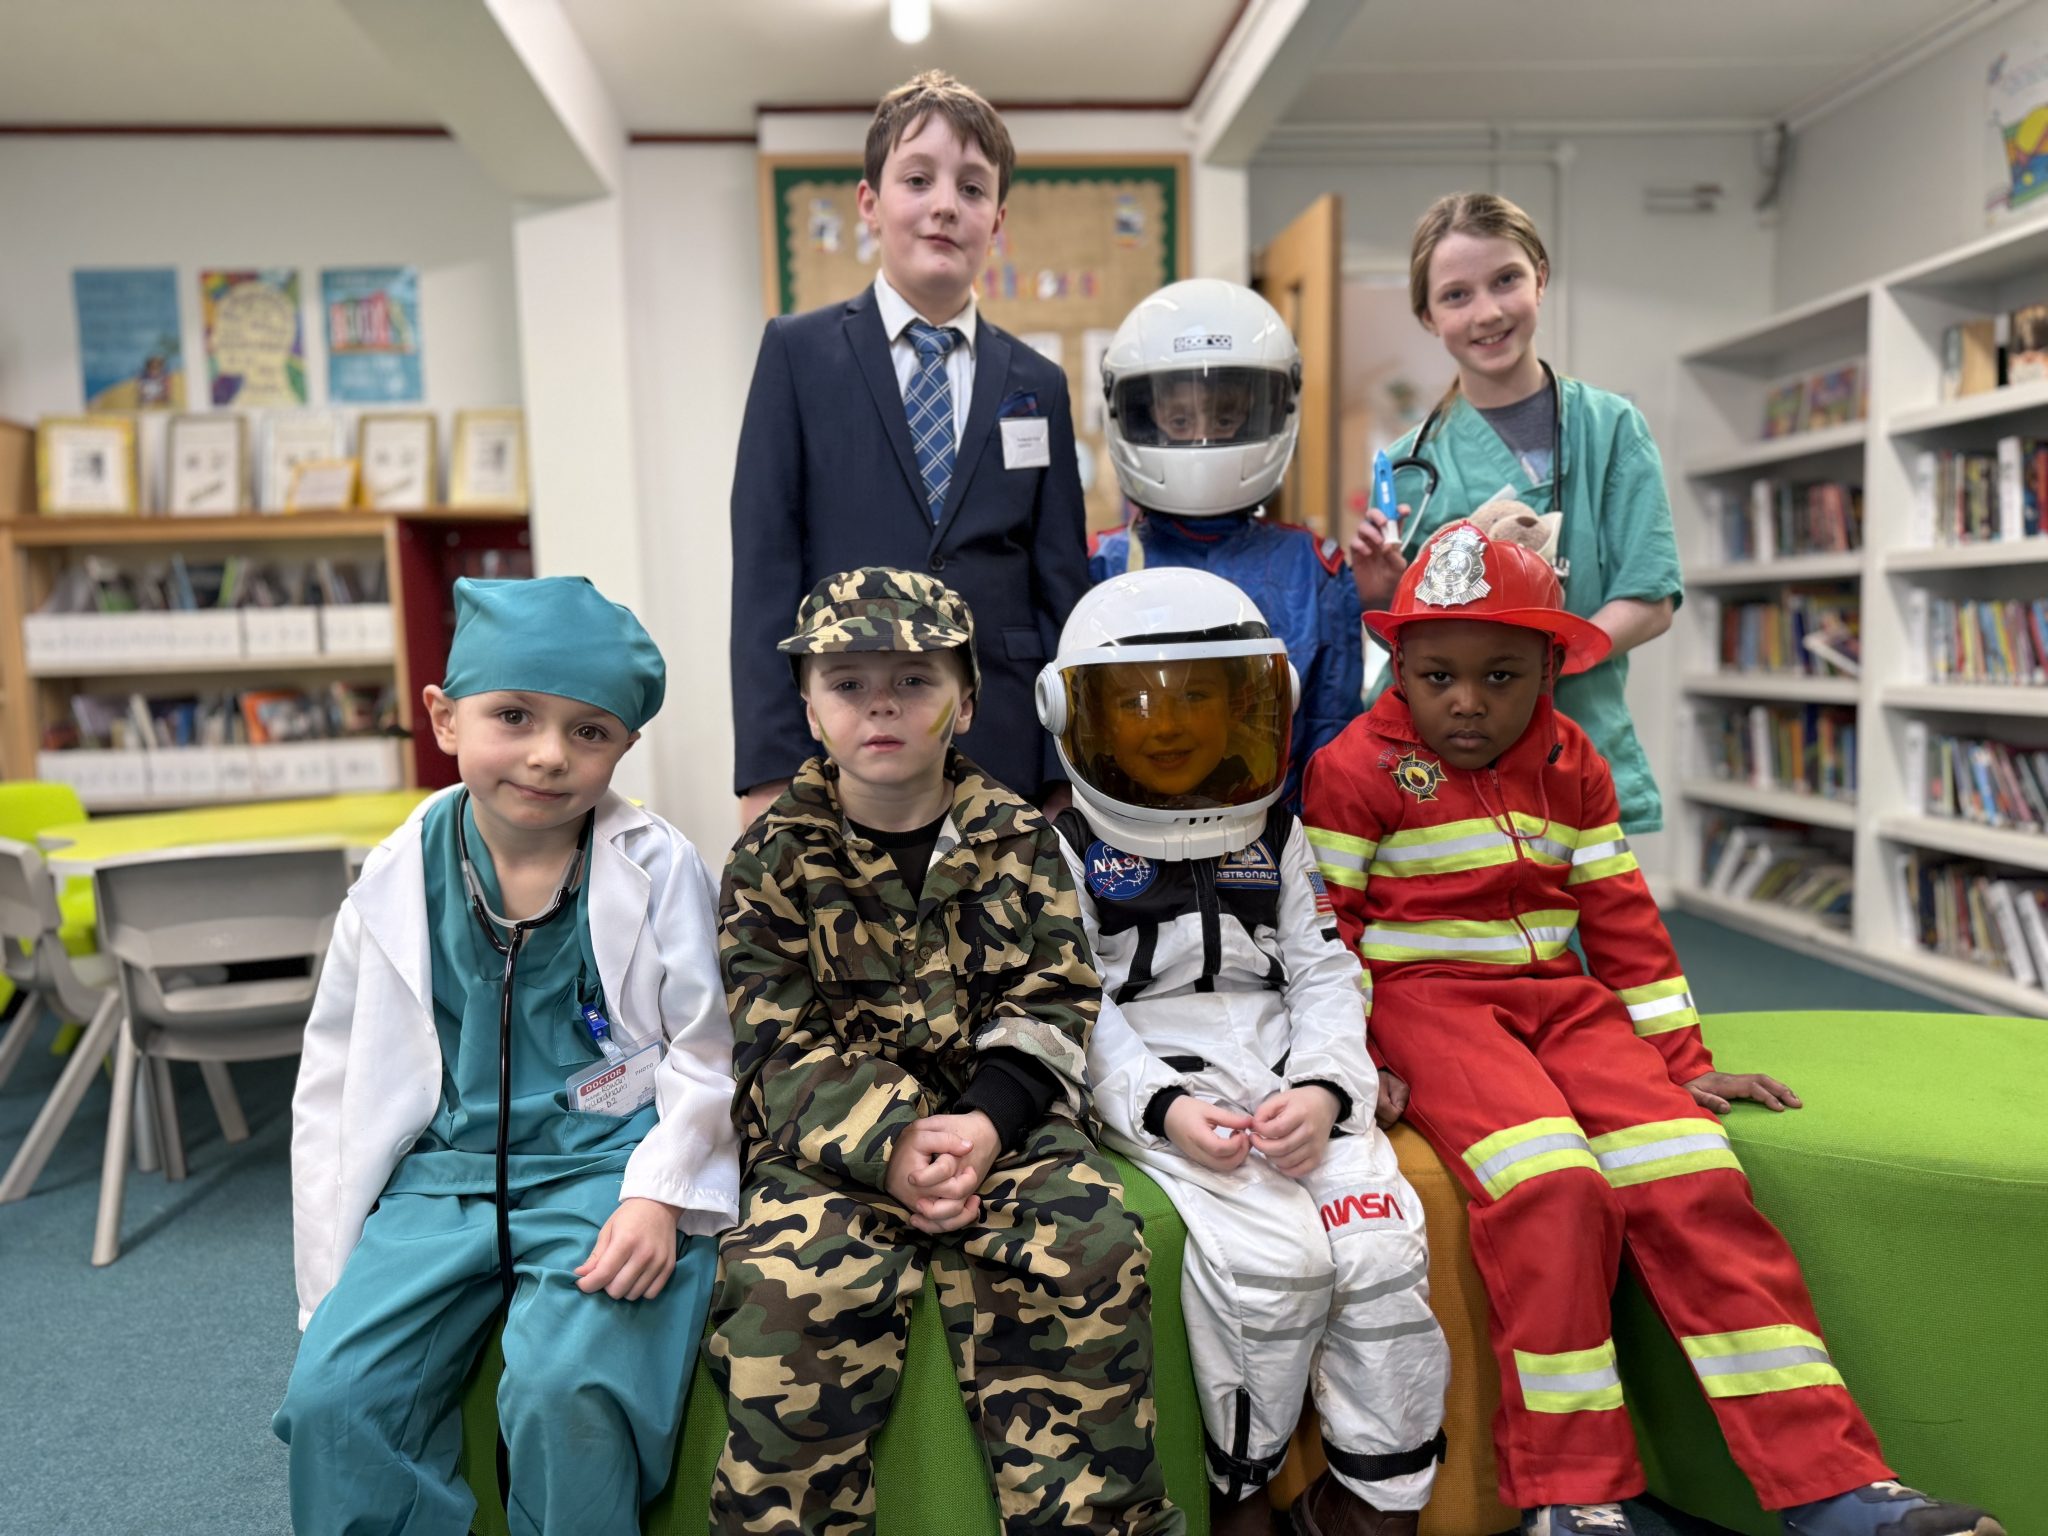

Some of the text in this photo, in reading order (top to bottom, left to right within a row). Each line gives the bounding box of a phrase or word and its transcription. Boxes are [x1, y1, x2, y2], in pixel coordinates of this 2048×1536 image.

[1093, 857, 1151, 873] NASA
[1216, 871, 1278, 880] ASTRONAUT
[635, 1062, 654, 1076] PHOTO
[586, 1068, 622, 1093] DOCTOR
[1320, 1193, 1404, 1232] NASA
